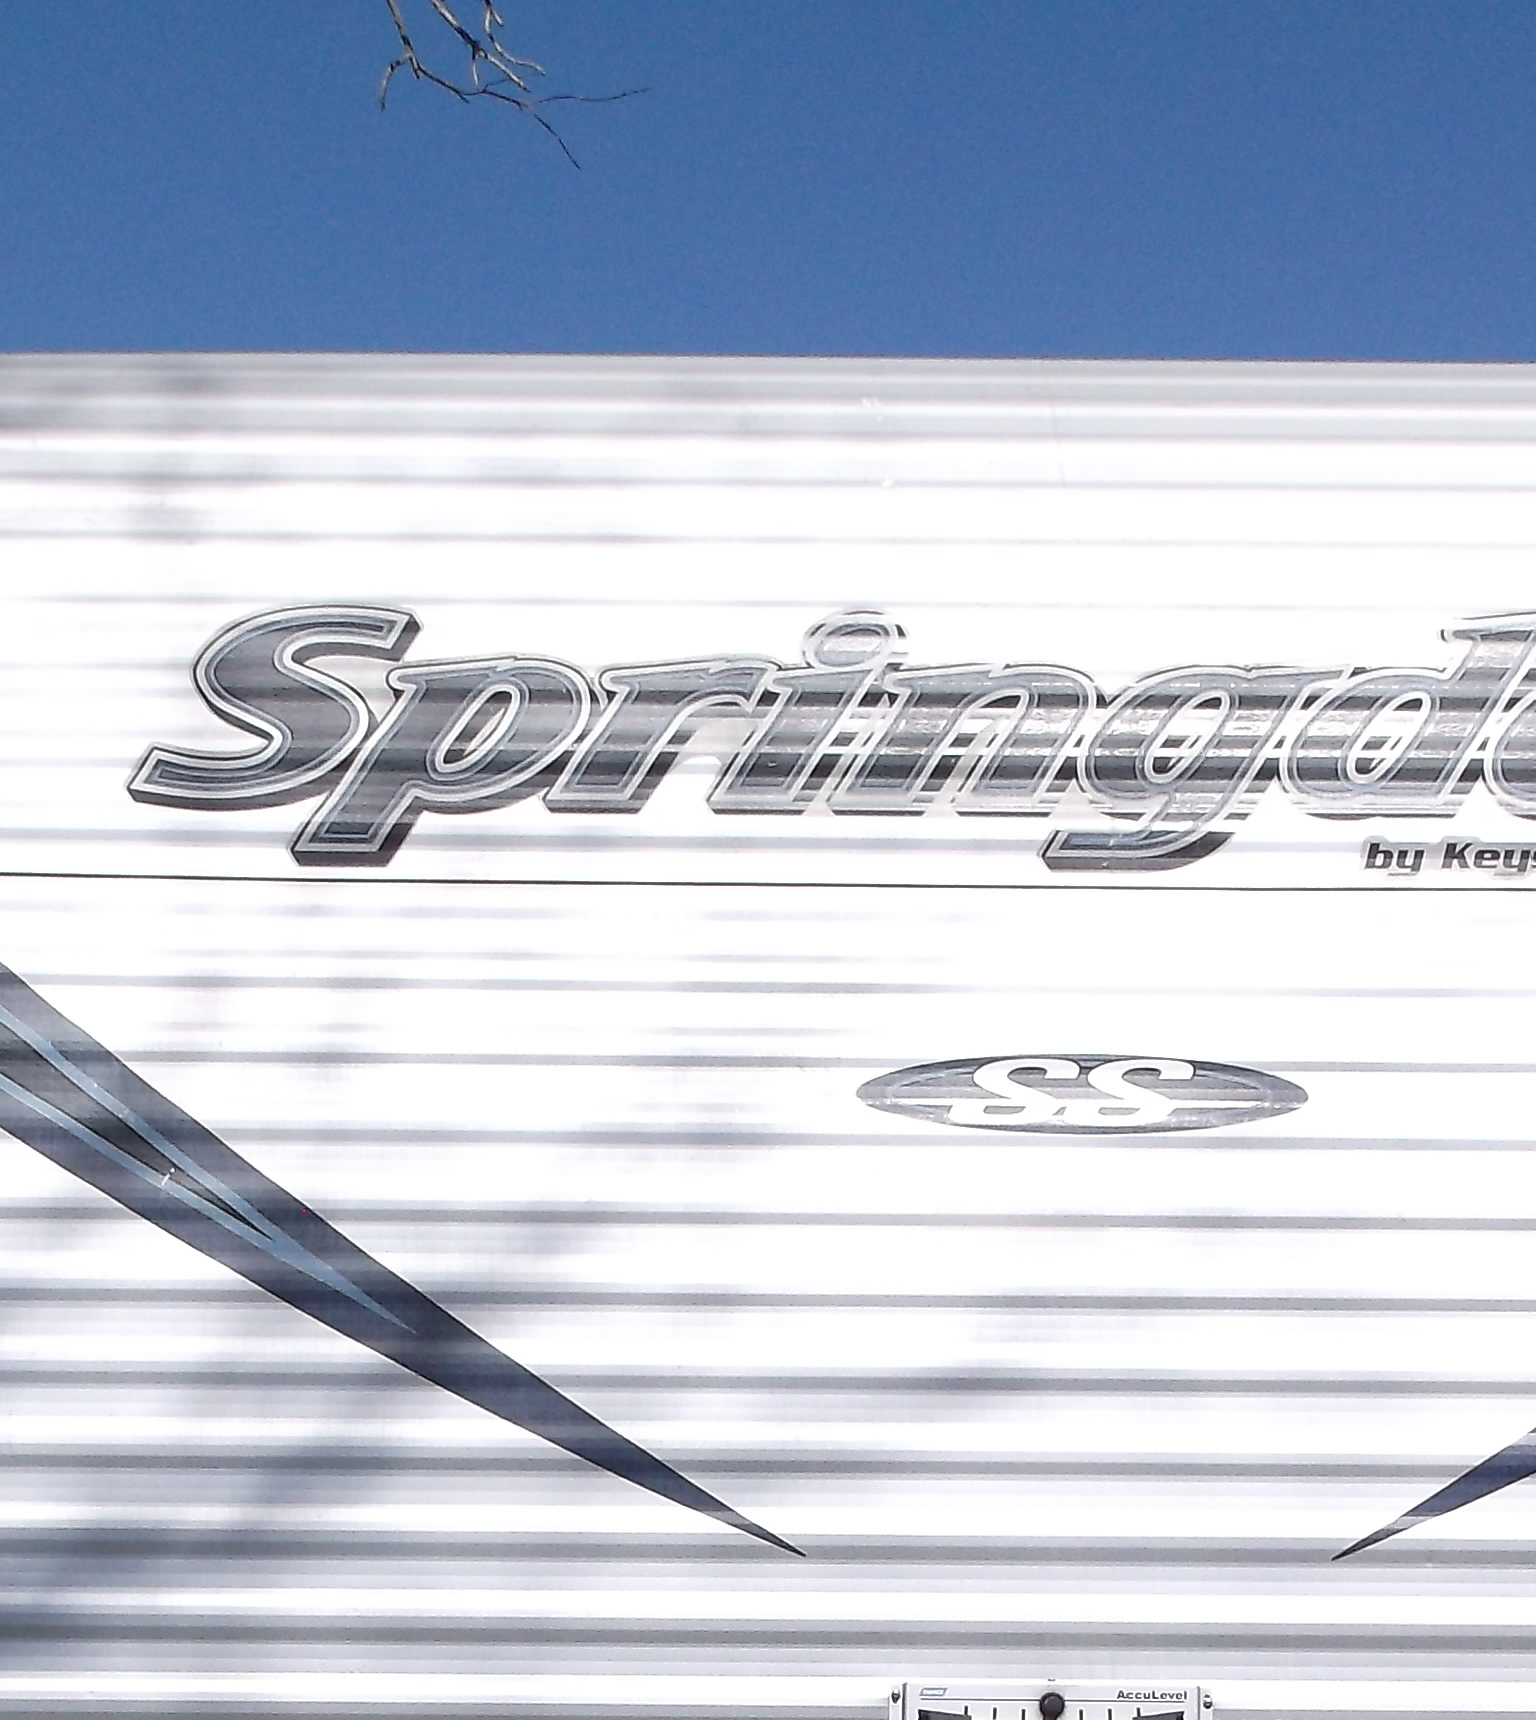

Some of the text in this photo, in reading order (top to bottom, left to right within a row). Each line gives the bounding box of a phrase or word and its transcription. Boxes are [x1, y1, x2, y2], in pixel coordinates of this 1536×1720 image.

[1364, 842, 1423, 876] by
[947, 1057, 1197, 1127] SS
[1116, 1689, 1188, 1700] AccuLevel
